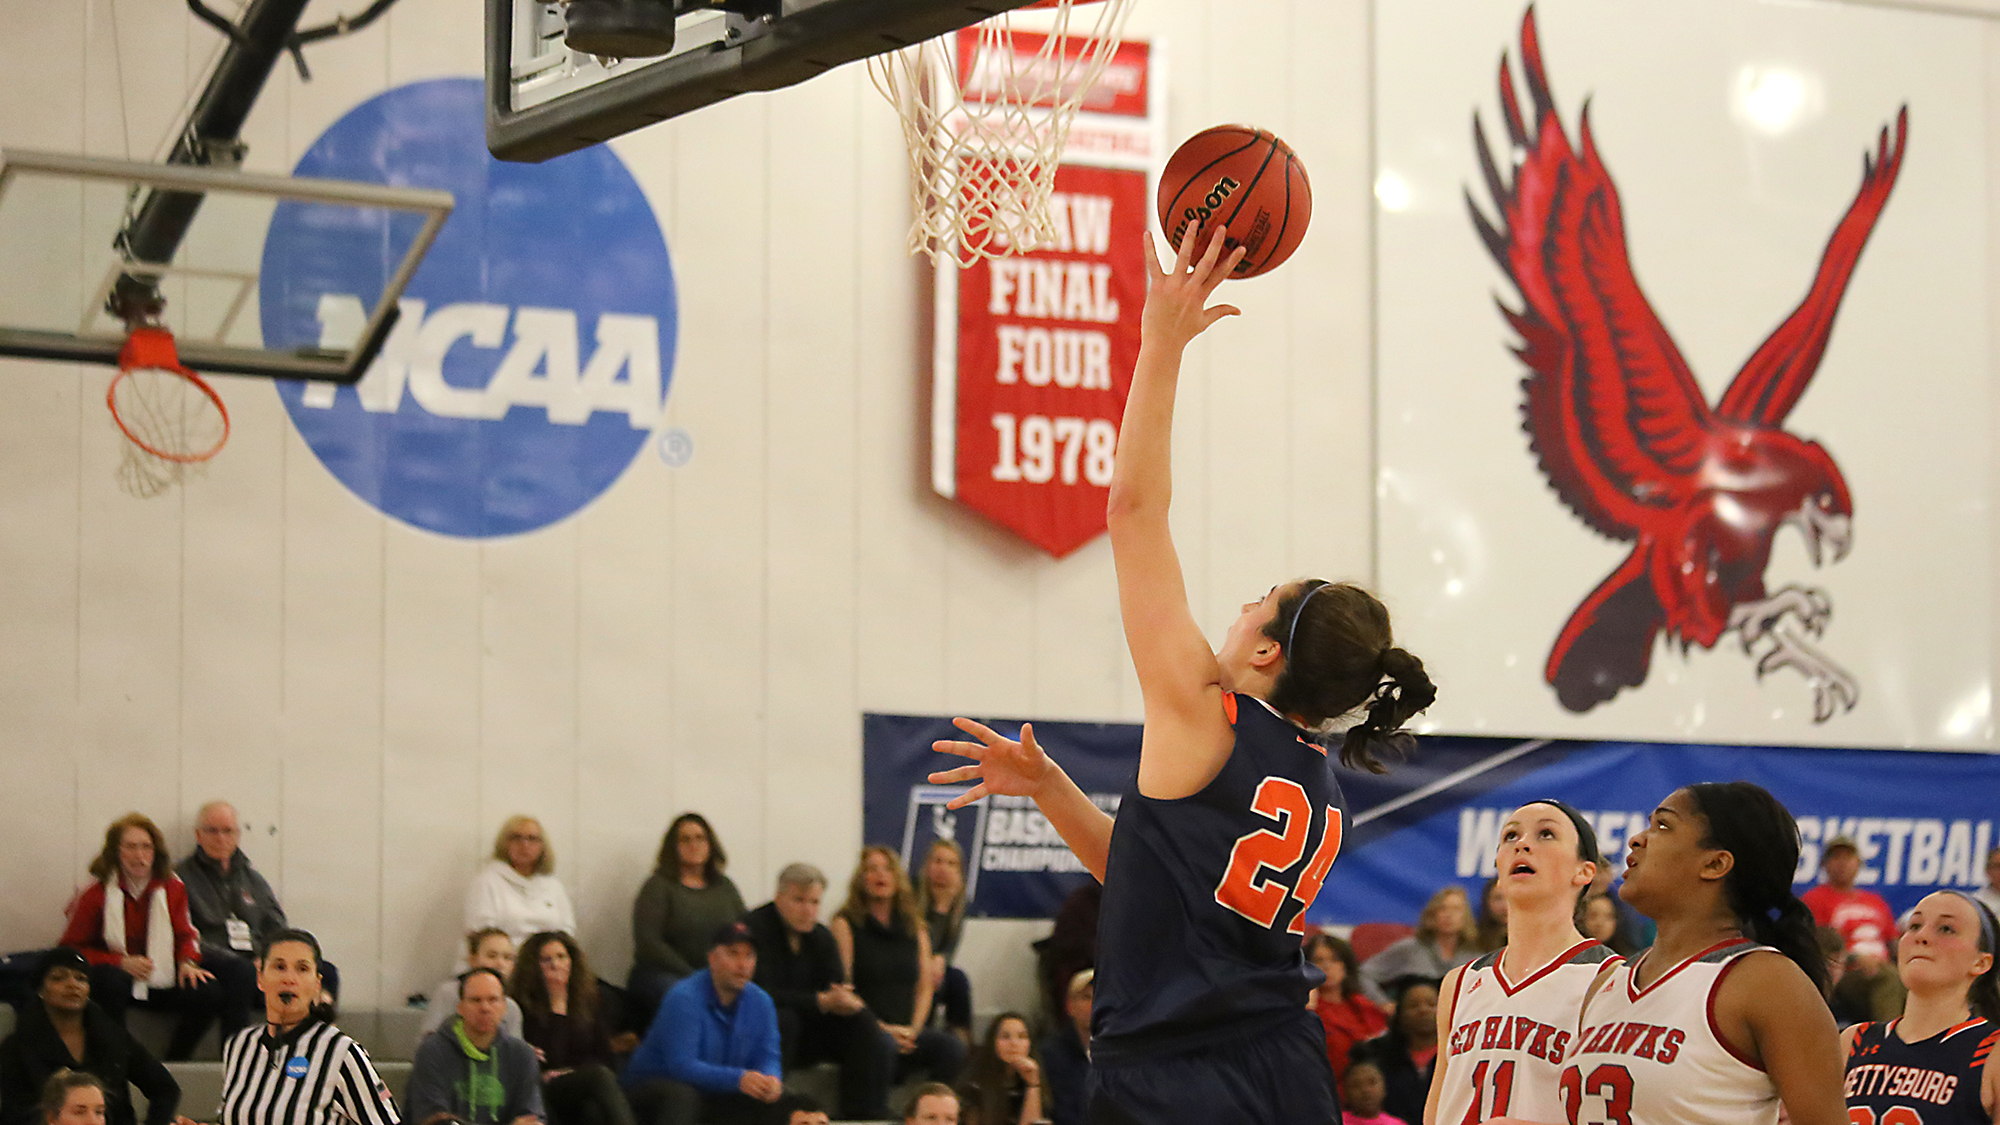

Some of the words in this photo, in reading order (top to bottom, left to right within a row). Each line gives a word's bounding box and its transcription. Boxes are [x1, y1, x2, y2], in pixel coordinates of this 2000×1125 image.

[988, 260, 1120, 324] FINAL
[302, 293, 662, 430] NCAA
[995, 324, 1112, 391] FOUR
[991, 413, 1117, 487] 1978
[1793, 816, 2000, 887] SETBAL
[1481, 1015, 1571, 1065] HAWKS
[1582, 1021, 1686, 1065] HAWKS
[1461, 1060, 1516, 1125] 11
